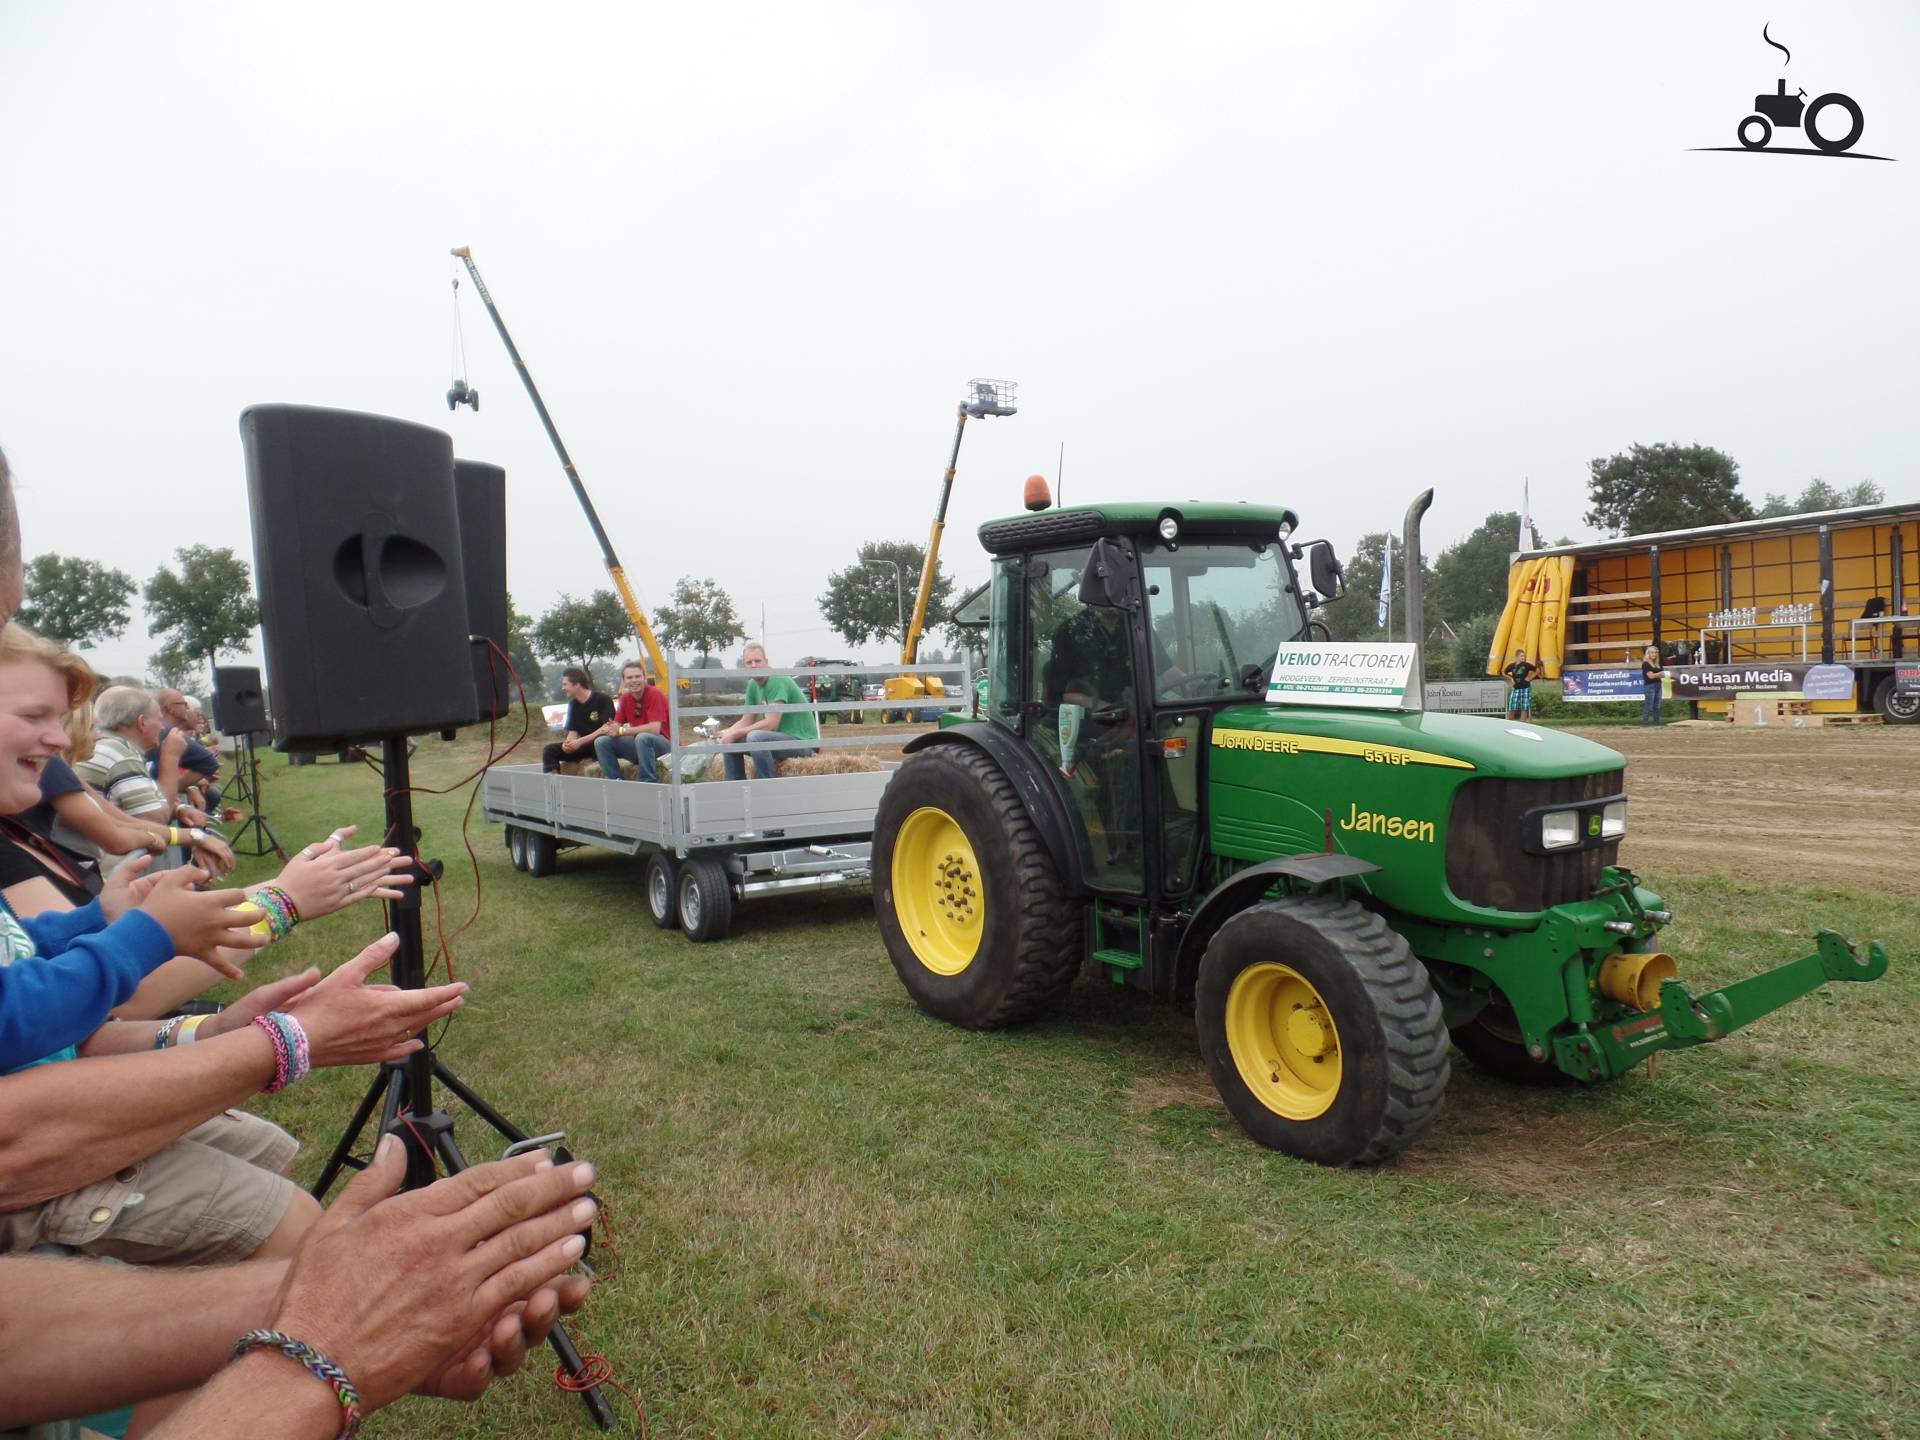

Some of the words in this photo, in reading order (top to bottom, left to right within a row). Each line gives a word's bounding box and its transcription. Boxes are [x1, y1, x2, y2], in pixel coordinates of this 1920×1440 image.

[1280, 653, 1321, 666] VEMO
[1322, 653, 1410, 669] TRACTOREN
[1279, 674, 1322, 683] HOOGEVEEN
[1328, 676, 1389, 685] ZEPPELINSTRAAT
[1680, 673, 1699, 685] De
[1702, 672, 1741, 684] Haan
[1744, 669, 1793, 683] Media
[1426, 689, 1440, 699] John
[1754, 703, 1769, 727] 1
[1219, 735, 1253, 751] JOHN
[1252, 737, 1299, 754] DEERE
[1364, 749, 1411, 766] 5515F
[1340, 802, 1435, 843] Jansen
